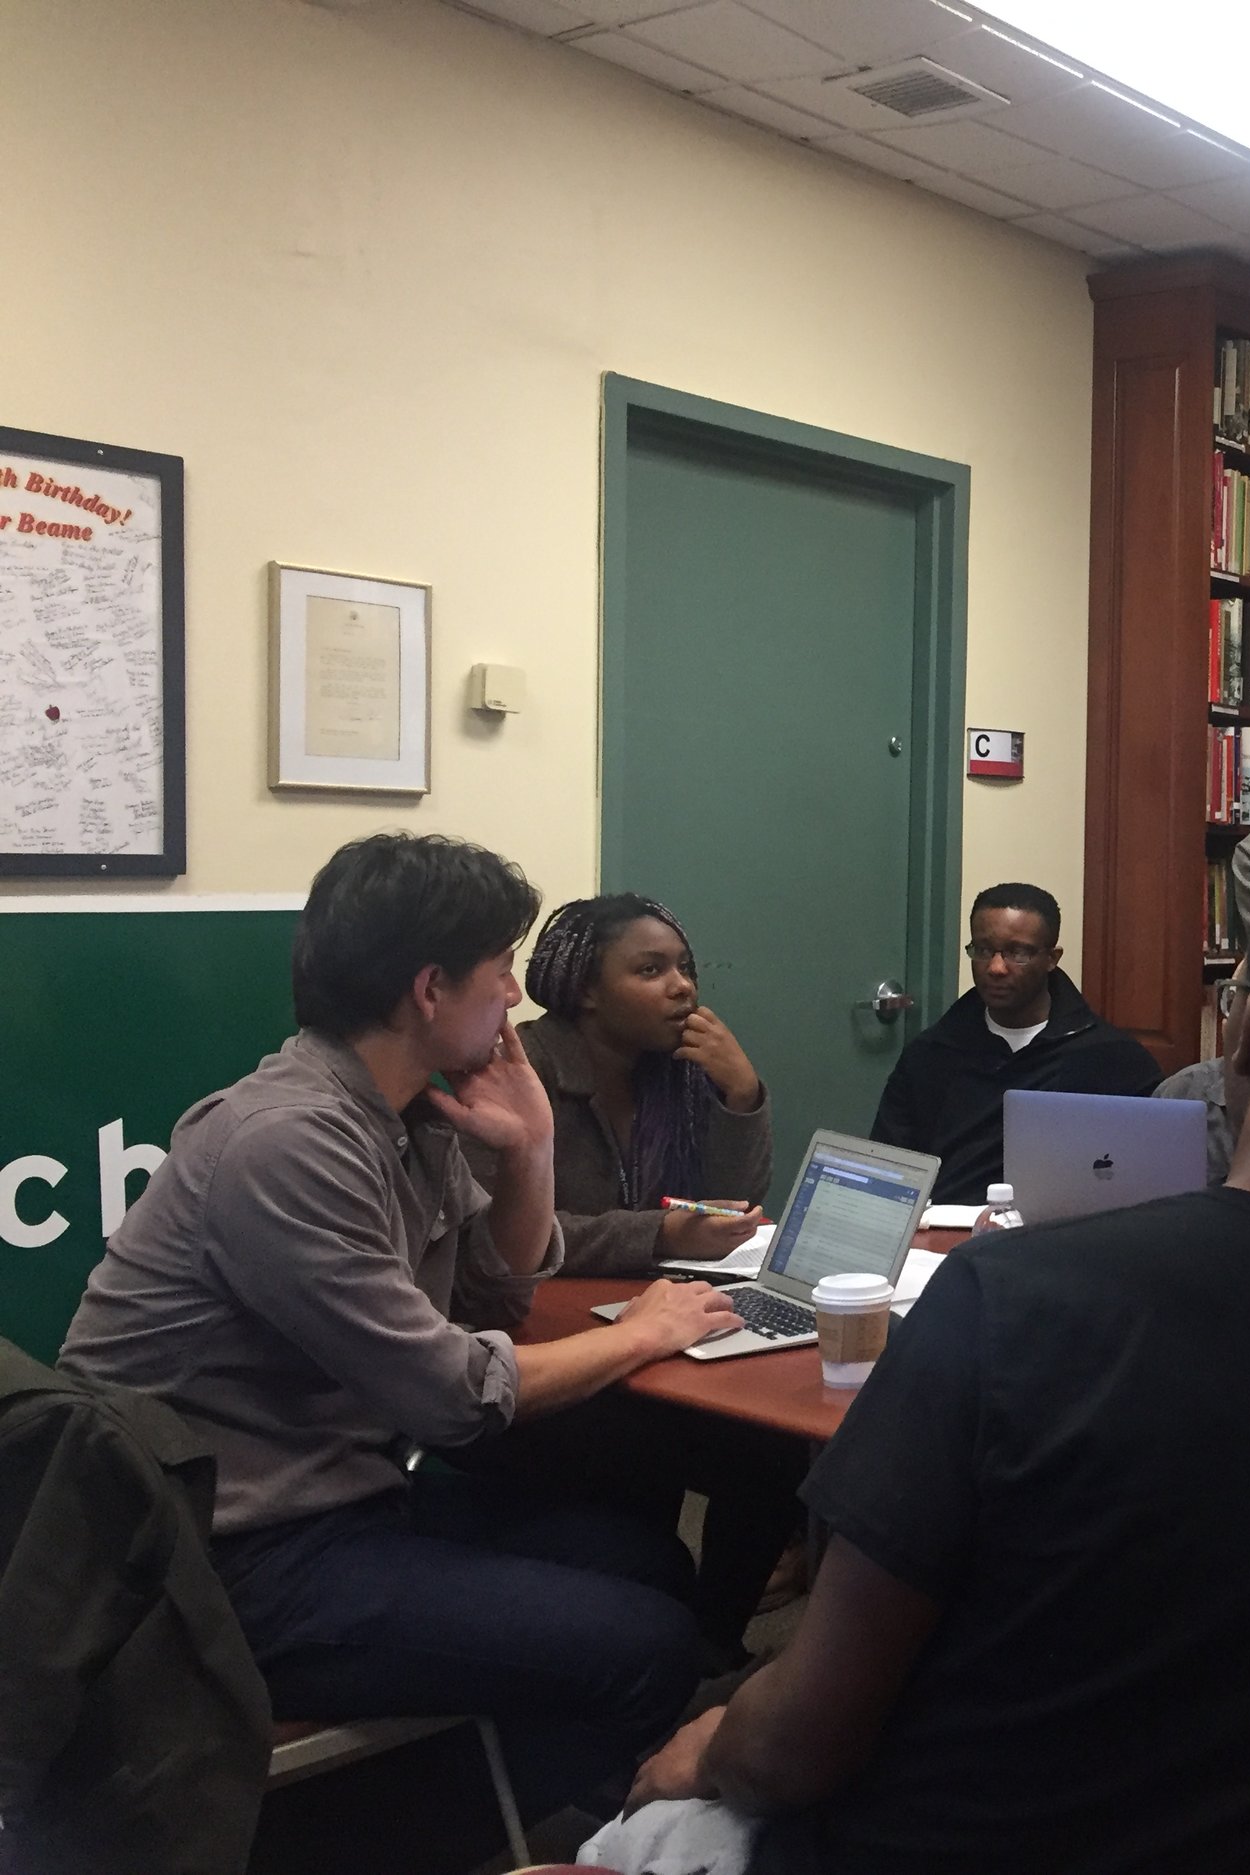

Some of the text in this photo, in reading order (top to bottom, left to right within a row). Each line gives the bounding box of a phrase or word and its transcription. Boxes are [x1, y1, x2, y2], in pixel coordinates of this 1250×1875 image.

[24, 471, 132, 526] Birthday!
[17, 512, 93, 541] Beame
[975, 734, 990, 758] C
